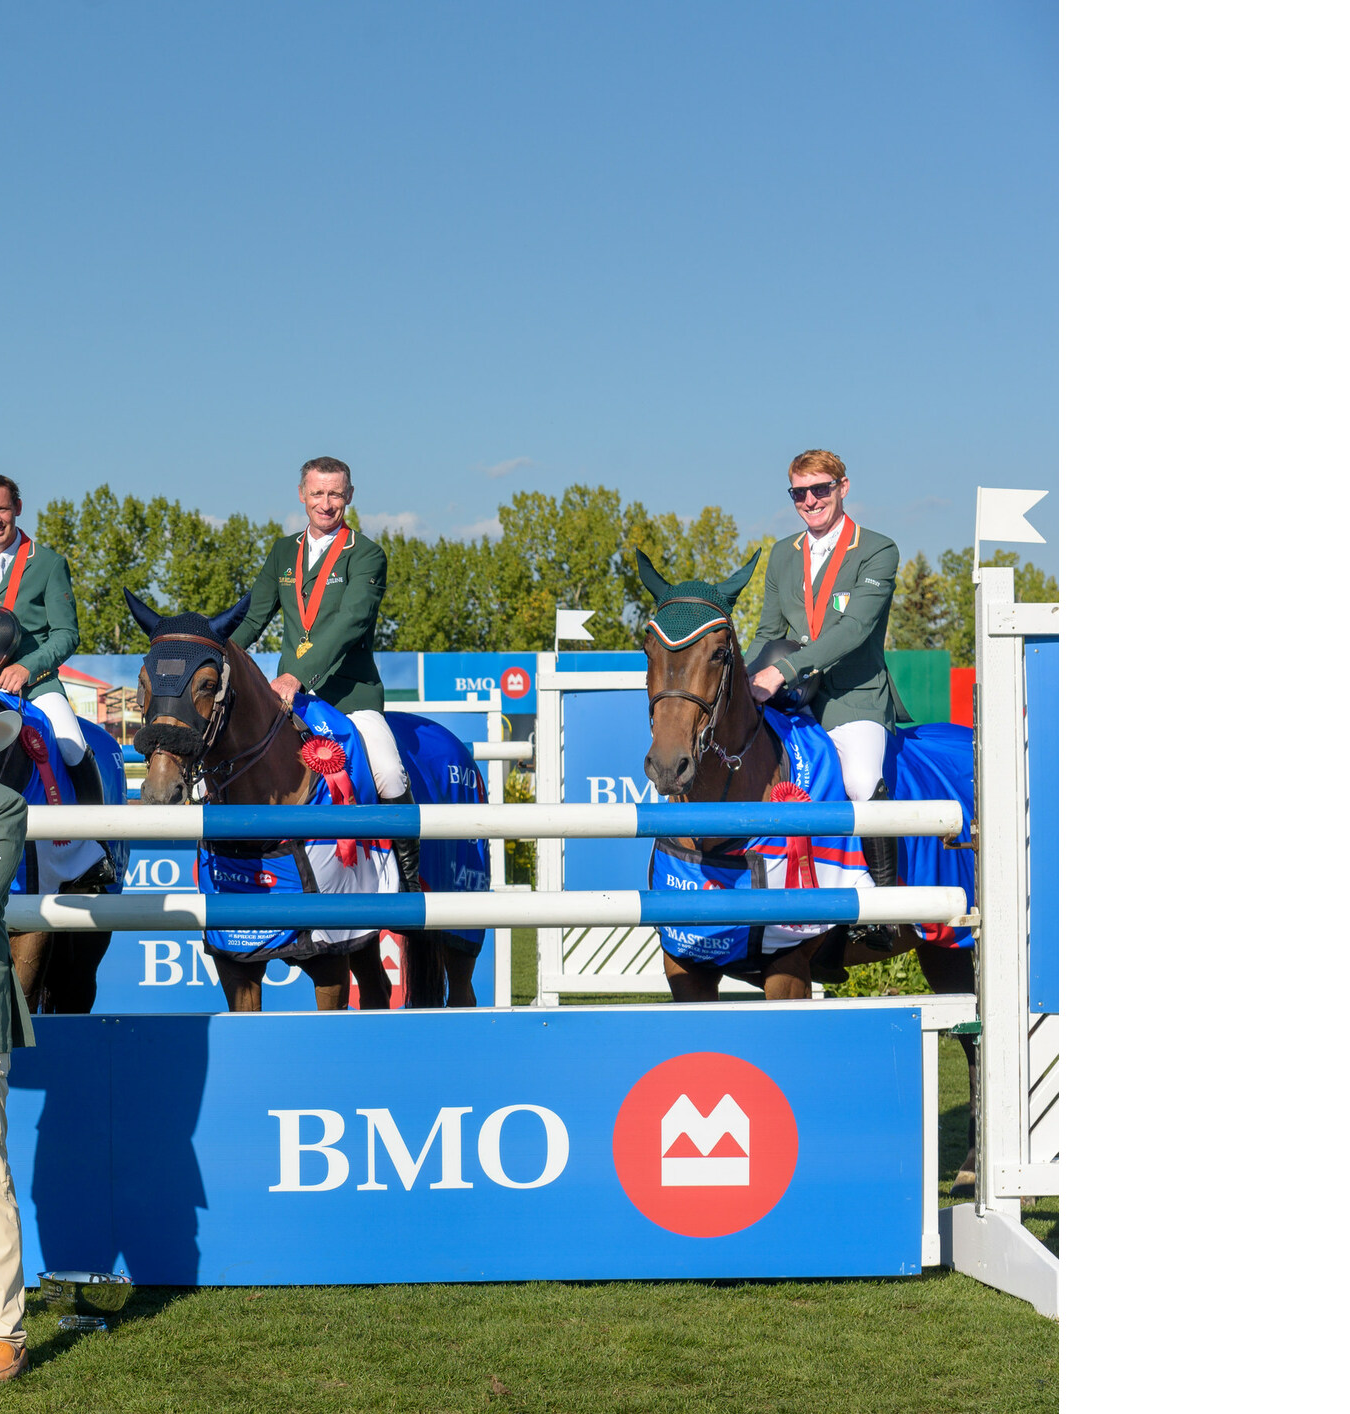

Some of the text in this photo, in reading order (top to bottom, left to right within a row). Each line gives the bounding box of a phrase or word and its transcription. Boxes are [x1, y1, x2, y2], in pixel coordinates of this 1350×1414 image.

[455, 677, 495, 692] BMO
[448, 765, 478, 789] BMO
[586, 776, 670, 804] BM
[123, 859, 180, 887] MO
[213, 869, 250, 884] BMO
[268, 1104, 571, 1192] BMO
